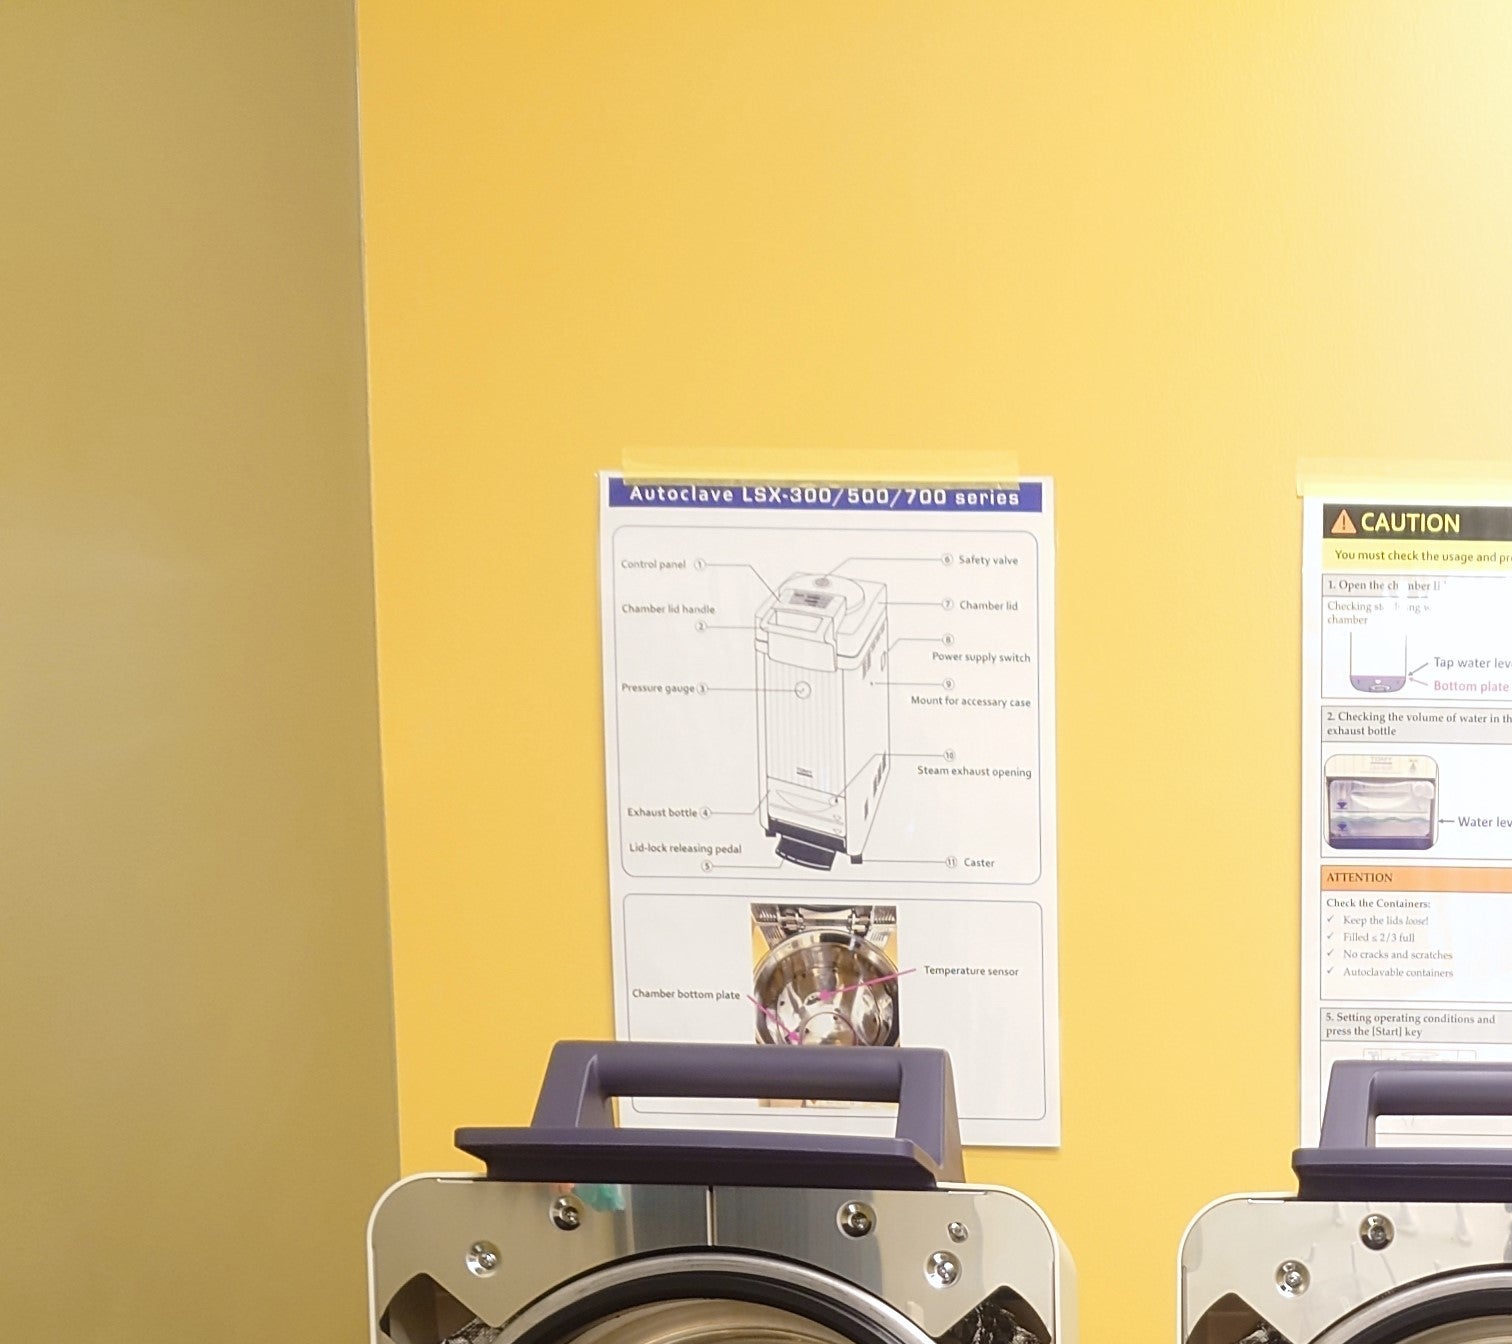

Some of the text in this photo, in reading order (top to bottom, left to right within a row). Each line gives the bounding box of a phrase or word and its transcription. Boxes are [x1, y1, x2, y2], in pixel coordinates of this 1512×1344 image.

[630, 486, 1019, 507] Autoclave LSX-300/500/700 series
[1361, 513, 1460, 532] CAUTION
[959, 555, 1018, 566] Safety valve
[1335, 550, 1355, 561] You
[1358, 550, 1385, 561] must
[1388, 550, 1418, 562] check
[1422, 551, 1440, 562] the
[1443, 553, 1473, 565] usage
[1476, 552, 1496, 563] and
[621, 560, 686, 571] Control panel
[621, 604, 715, 614] Chamber lid handle
[932, 652, 1031, 665] Power supply switch
[1434, 657, 1458, 669] Tap
[1461, 658, 1493, 668] water
[621, 684, 695, 695] Pressure gauge
[1434, 681, 1509, 694] Bottom plate
[911, 696, 1031, 710] Mount for accessary case
[917, 767, 1032, 780] Steam exhaust opening
[627, 808, 697, 818] Exhaust bottle
[629, 844, 741, 856] Lid-lock releasing pedal
[964, 858, 994, 868] Caster
[1327, 872, 1393, 883] ATTENTION
[924, 966, 1019, 978] Temperature sensor
[632, 989, 741, 1002] Chamber bottom plate
